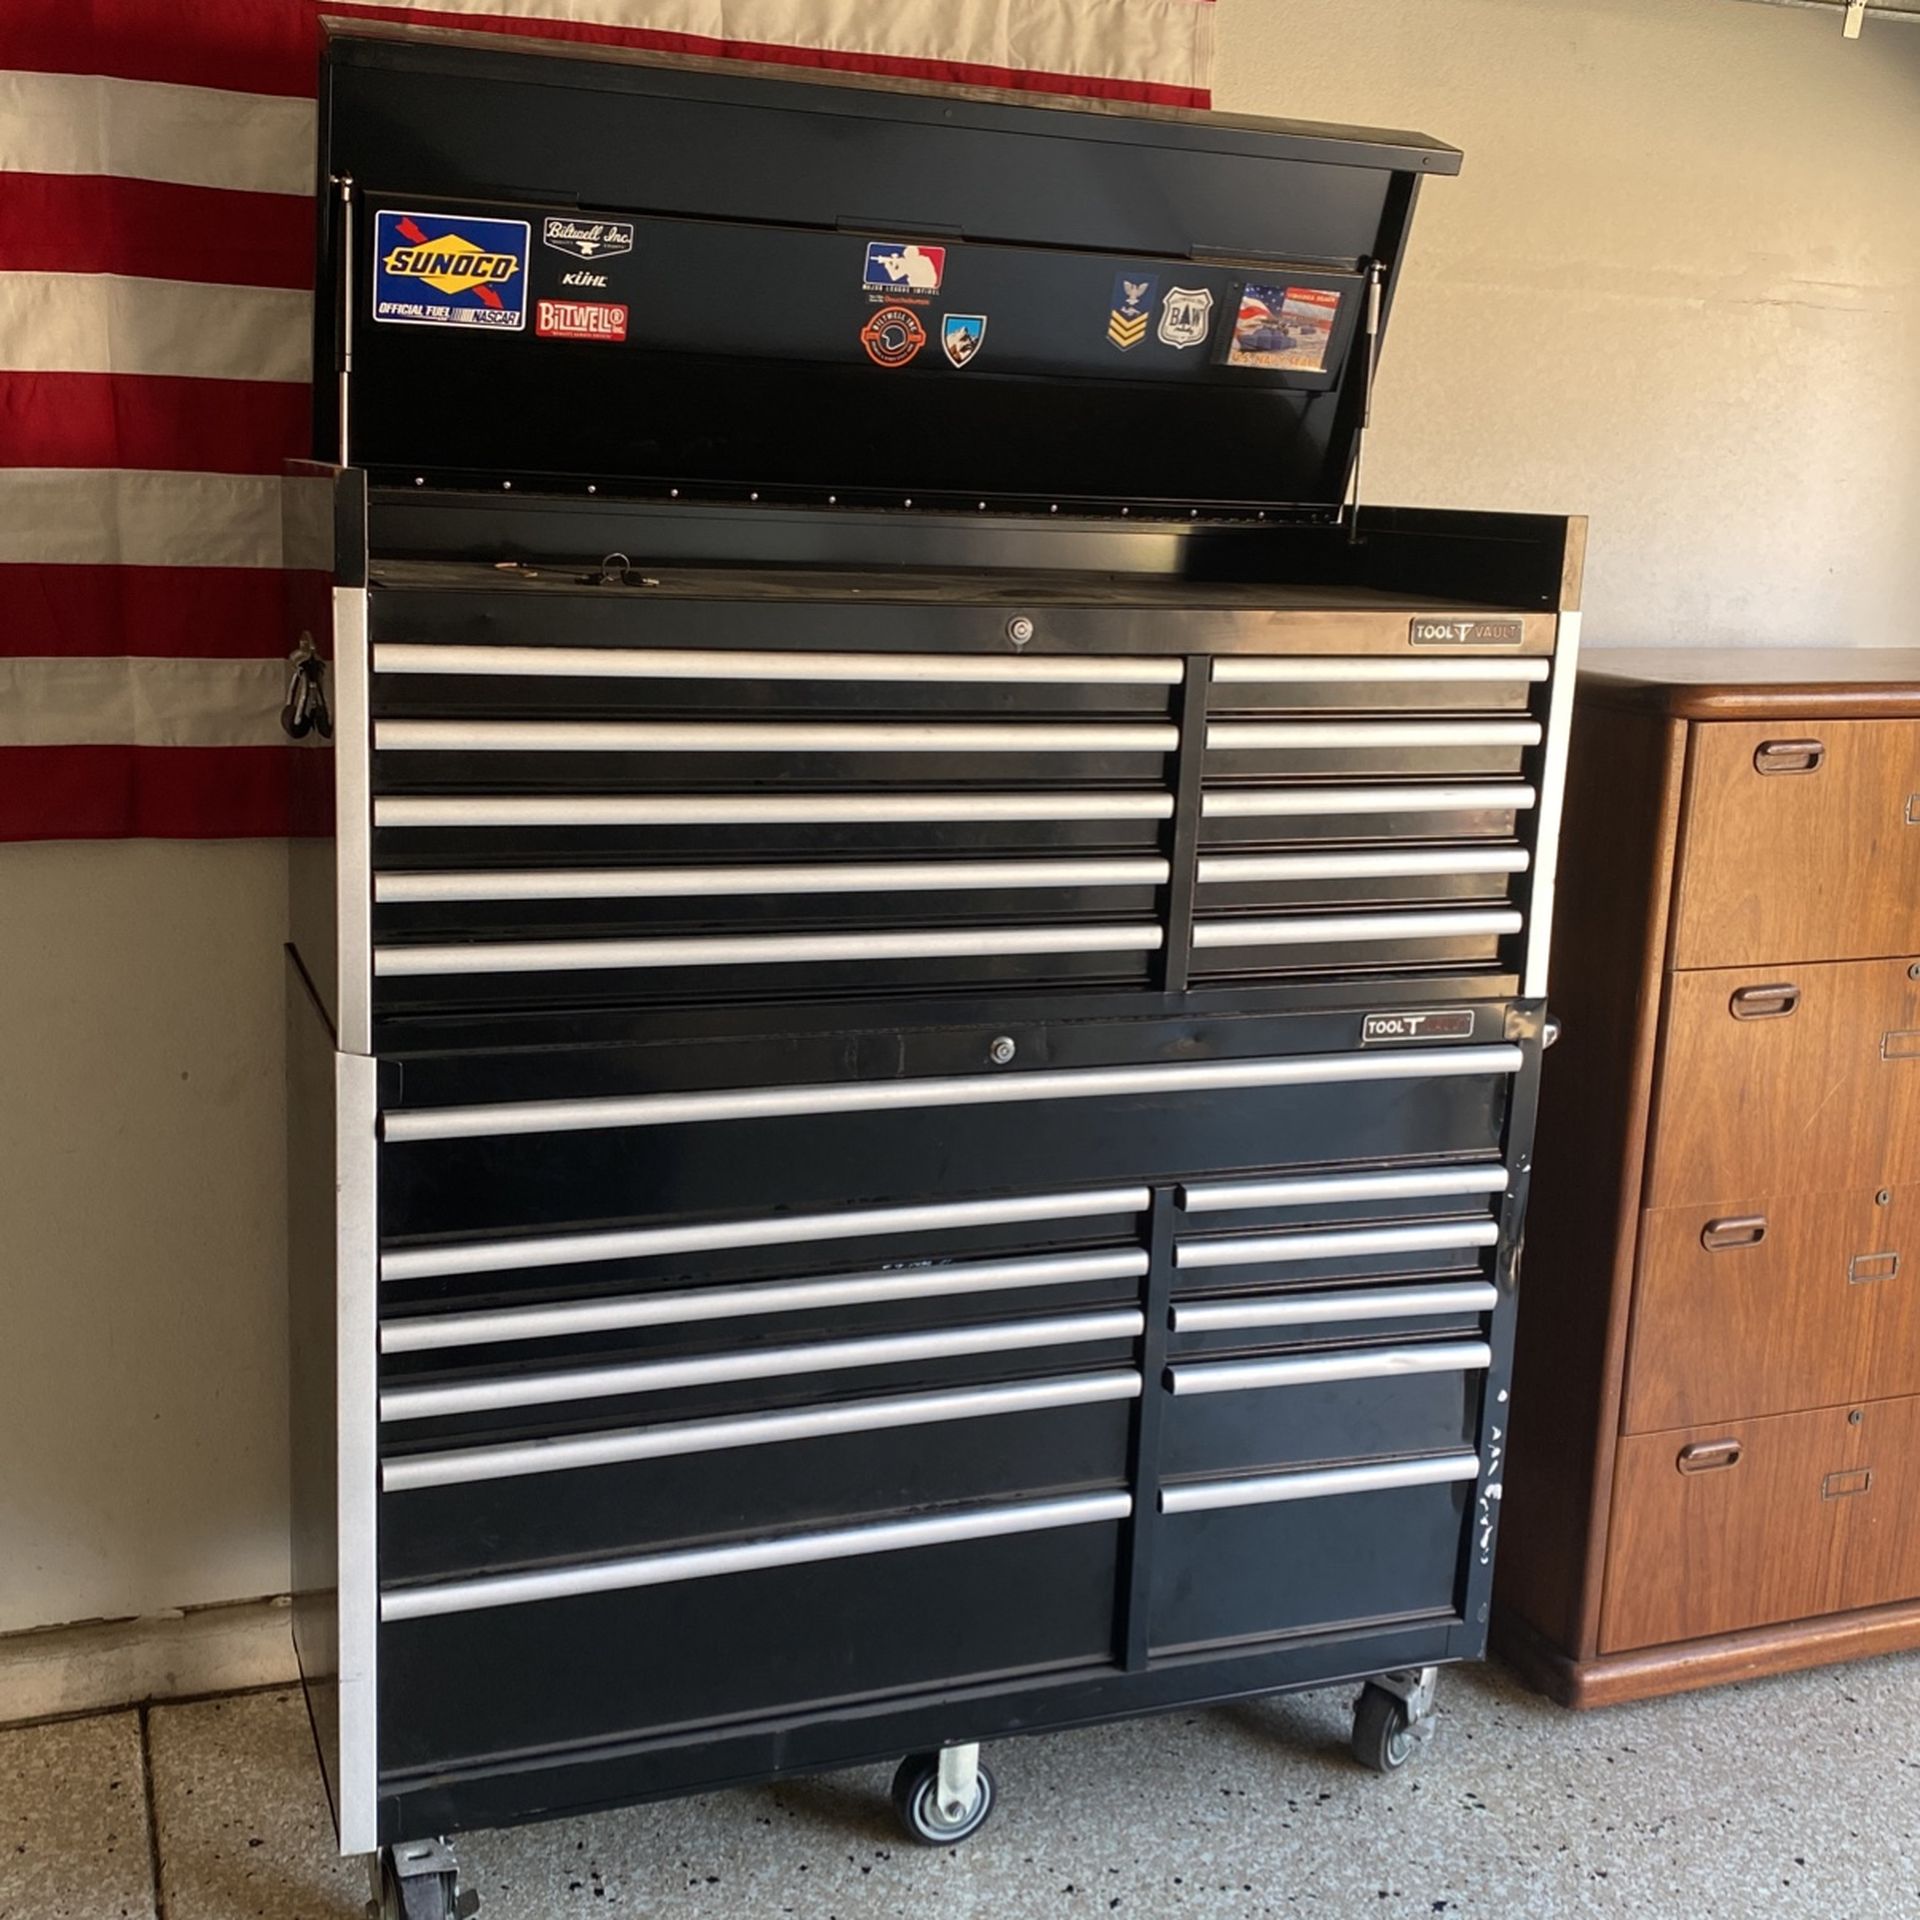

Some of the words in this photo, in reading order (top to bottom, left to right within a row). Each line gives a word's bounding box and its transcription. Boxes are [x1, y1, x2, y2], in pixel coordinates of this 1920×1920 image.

[547, 221, 603, 241] Biltwell
[390, 250, 513, 279] SUNOCO
[562, 271, 608, 288] KÜHL
[379, 303, 423, 316] OFFICIAL
[426, 305, 450, 317] FUEL
[472, 310, 517, 325] NASCAR
[1417, 625, 1454, 640] TOOL
[1476, 625, 1517, 638] VAULT
[1368, 1020, 1405, 1034] TOOL
